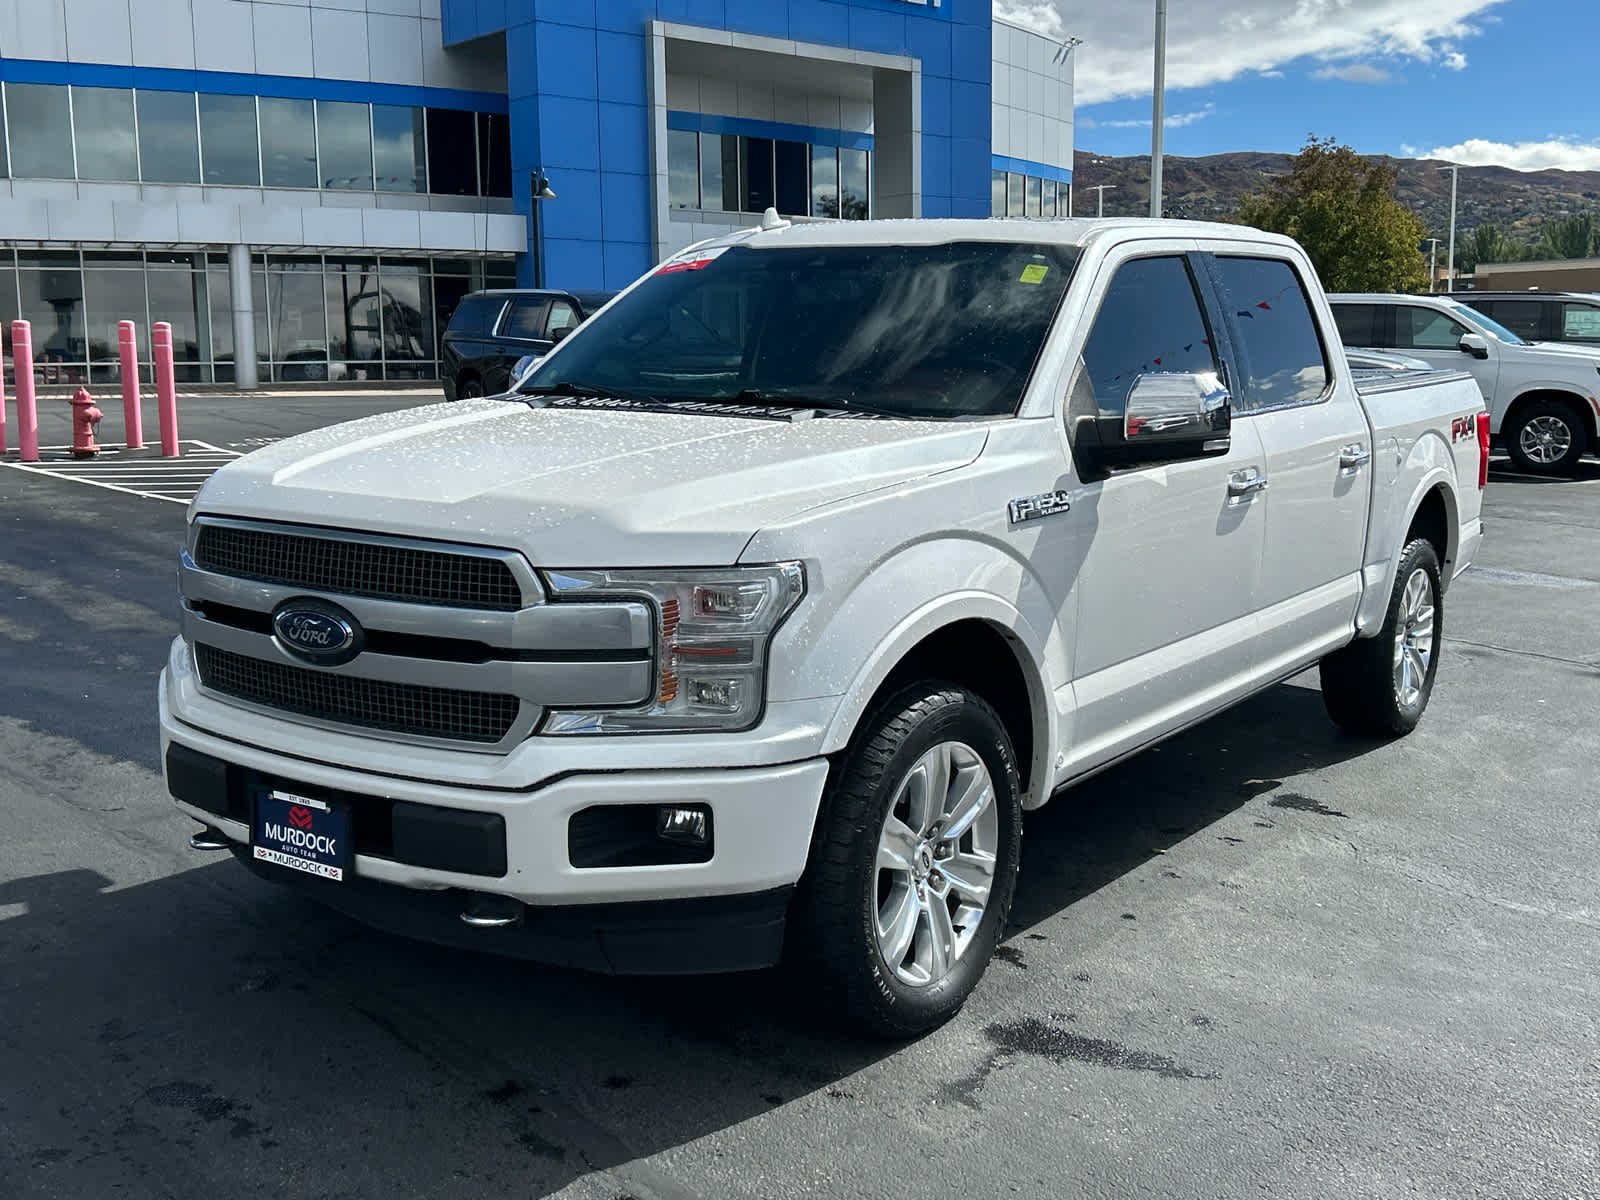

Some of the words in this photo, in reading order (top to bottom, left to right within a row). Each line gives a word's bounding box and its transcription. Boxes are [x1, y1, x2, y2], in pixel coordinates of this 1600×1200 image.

[1452, 414, 1475, 444] FX4
[289, 616, 331, 645] Ford
[265, 822, 336, 855] MURDOCK
[281, 844, 298, 854] AUTO
[300, 849, 317, 859] TEAM
[273, 853, 322, 873] MURDOCK
